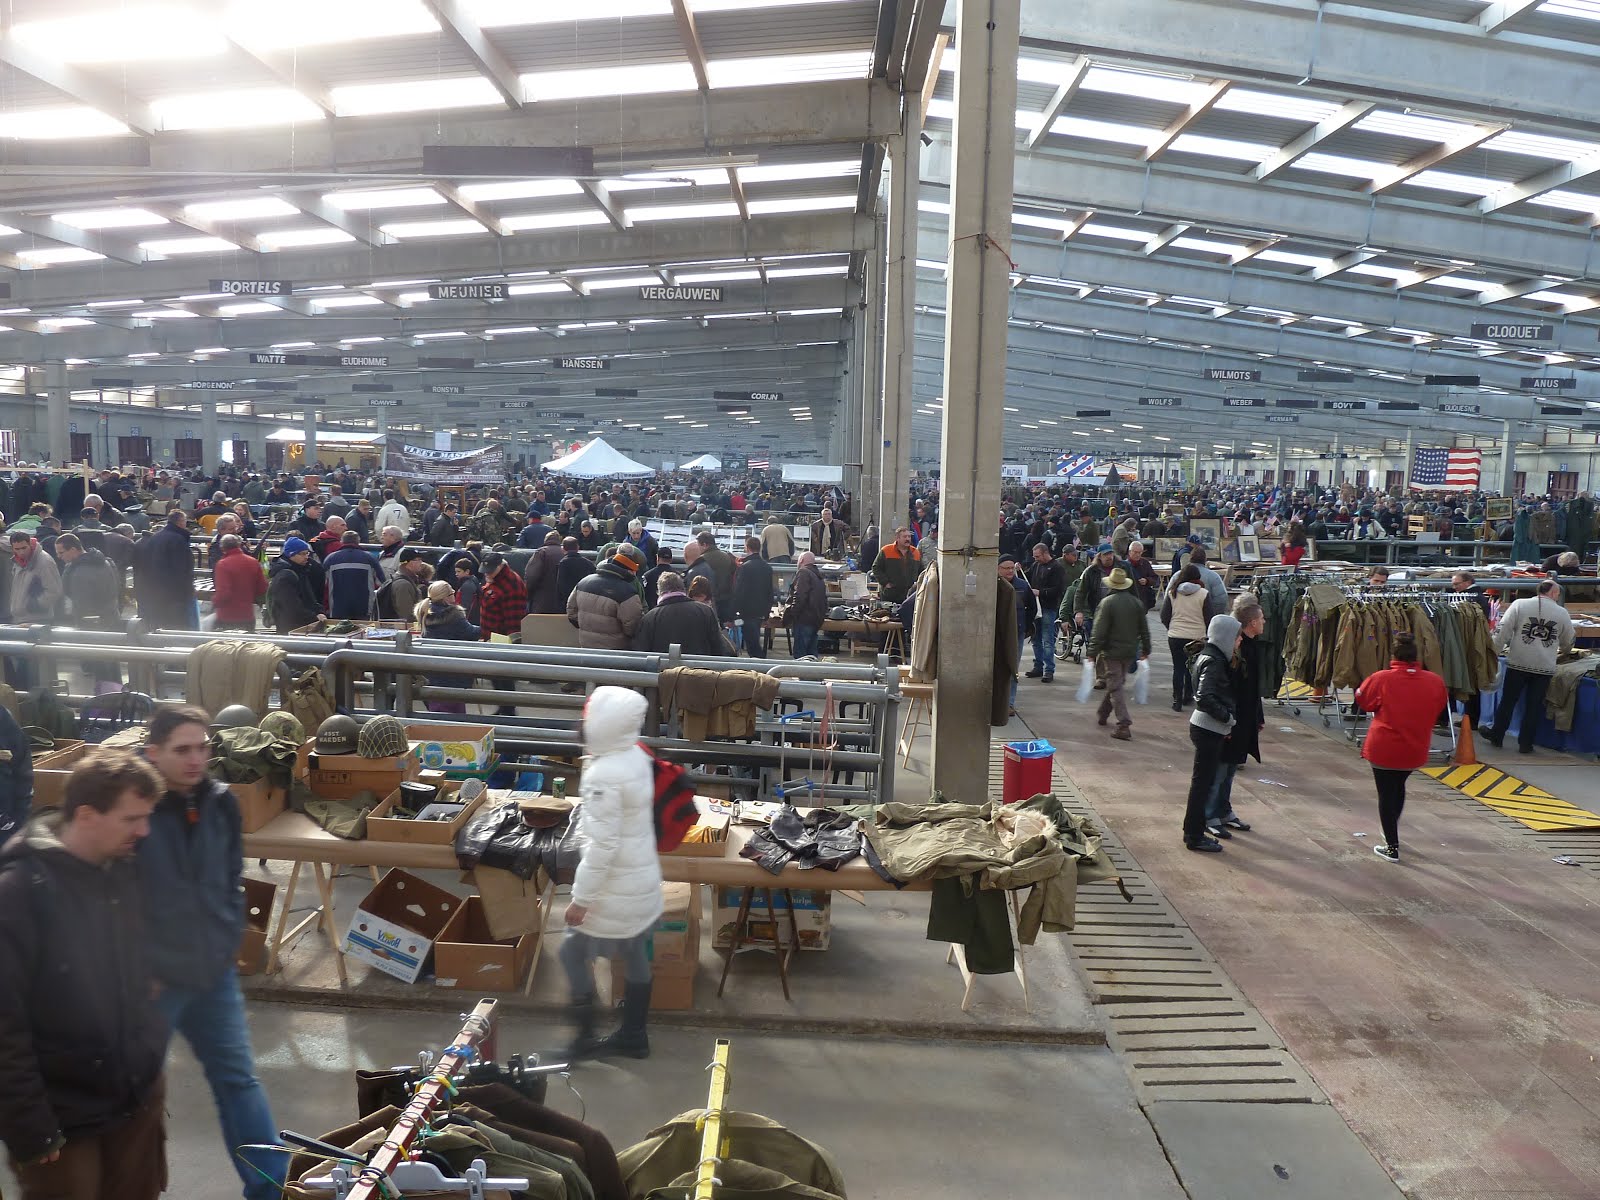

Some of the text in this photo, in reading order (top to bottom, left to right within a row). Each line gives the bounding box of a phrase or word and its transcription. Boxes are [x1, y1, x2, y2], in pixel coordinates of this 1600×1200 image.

[221, 281, 282, 294] BORTELS
[438, 285, 502, 299] MEUNIER
[641, 286, 720, 301] VERGAUWEN
[1487, 325, 1541, 339] CLOQUET
[256, 354, 286, 364] WATTE
[562, 359, 603, 369] HANSSEN
[1211, 370, 1251, 380] WILMOTS
[1533, 379, 1559, 388] ANUS
[432, 386, 459, 394] RONSYN
[751, 392, 778, 401] CORIJN
[1148, 398, 1173, 406] WOLFS
[1444, 404, 1476, 413] DUQUESNE
